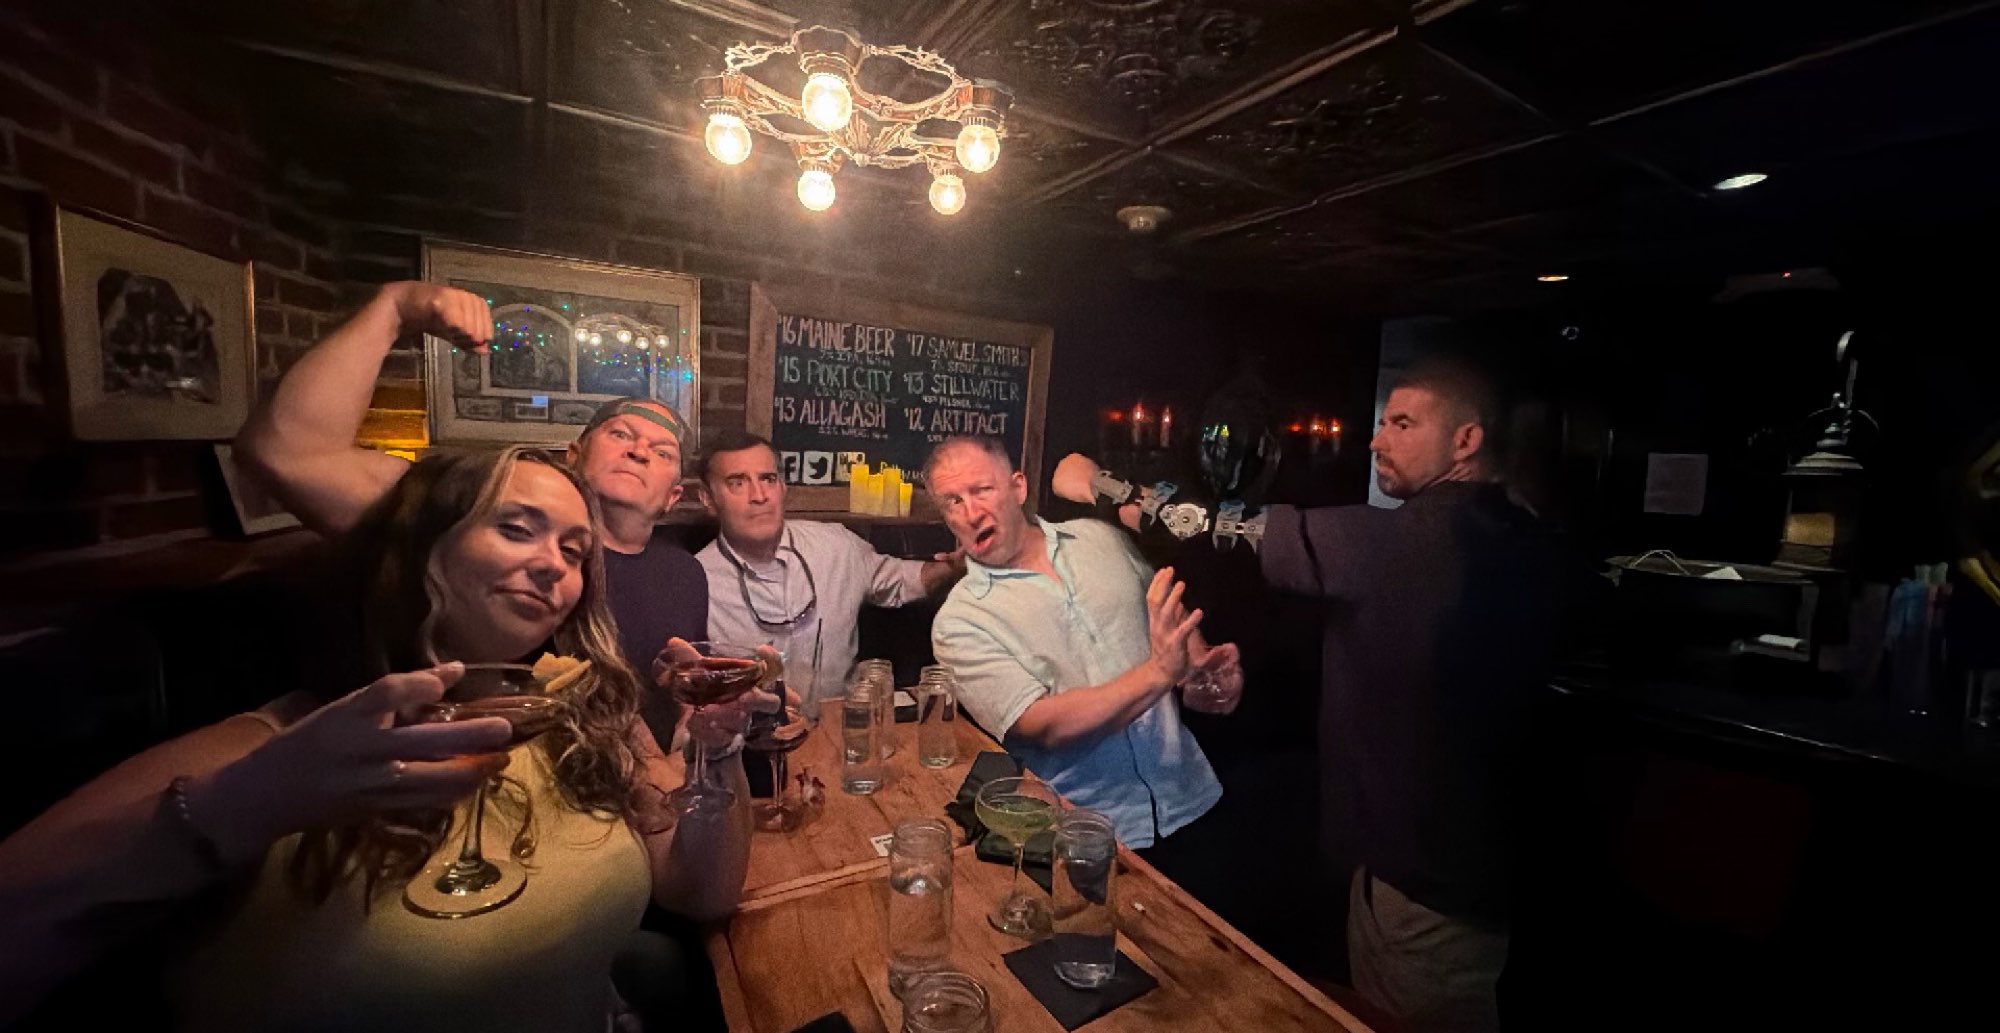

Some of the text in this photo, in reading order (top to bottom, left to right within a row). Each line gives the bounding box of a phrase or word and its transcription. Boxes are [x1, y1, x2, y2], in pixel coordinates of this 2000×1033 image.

[798, 317, 852, 351] MAINE
[855, 324, 895, 357] BEER
[927, 336, 980, 362] SAMUEL
[807, 359, 850, 388] PORT
[853, 367, 893, 392] CITY
[931, 373, 1020, 401] STILLWATER
[800, 399, 886, 429] ALLAGASH
[931, 409, 1009, 435] ARTIFACT
